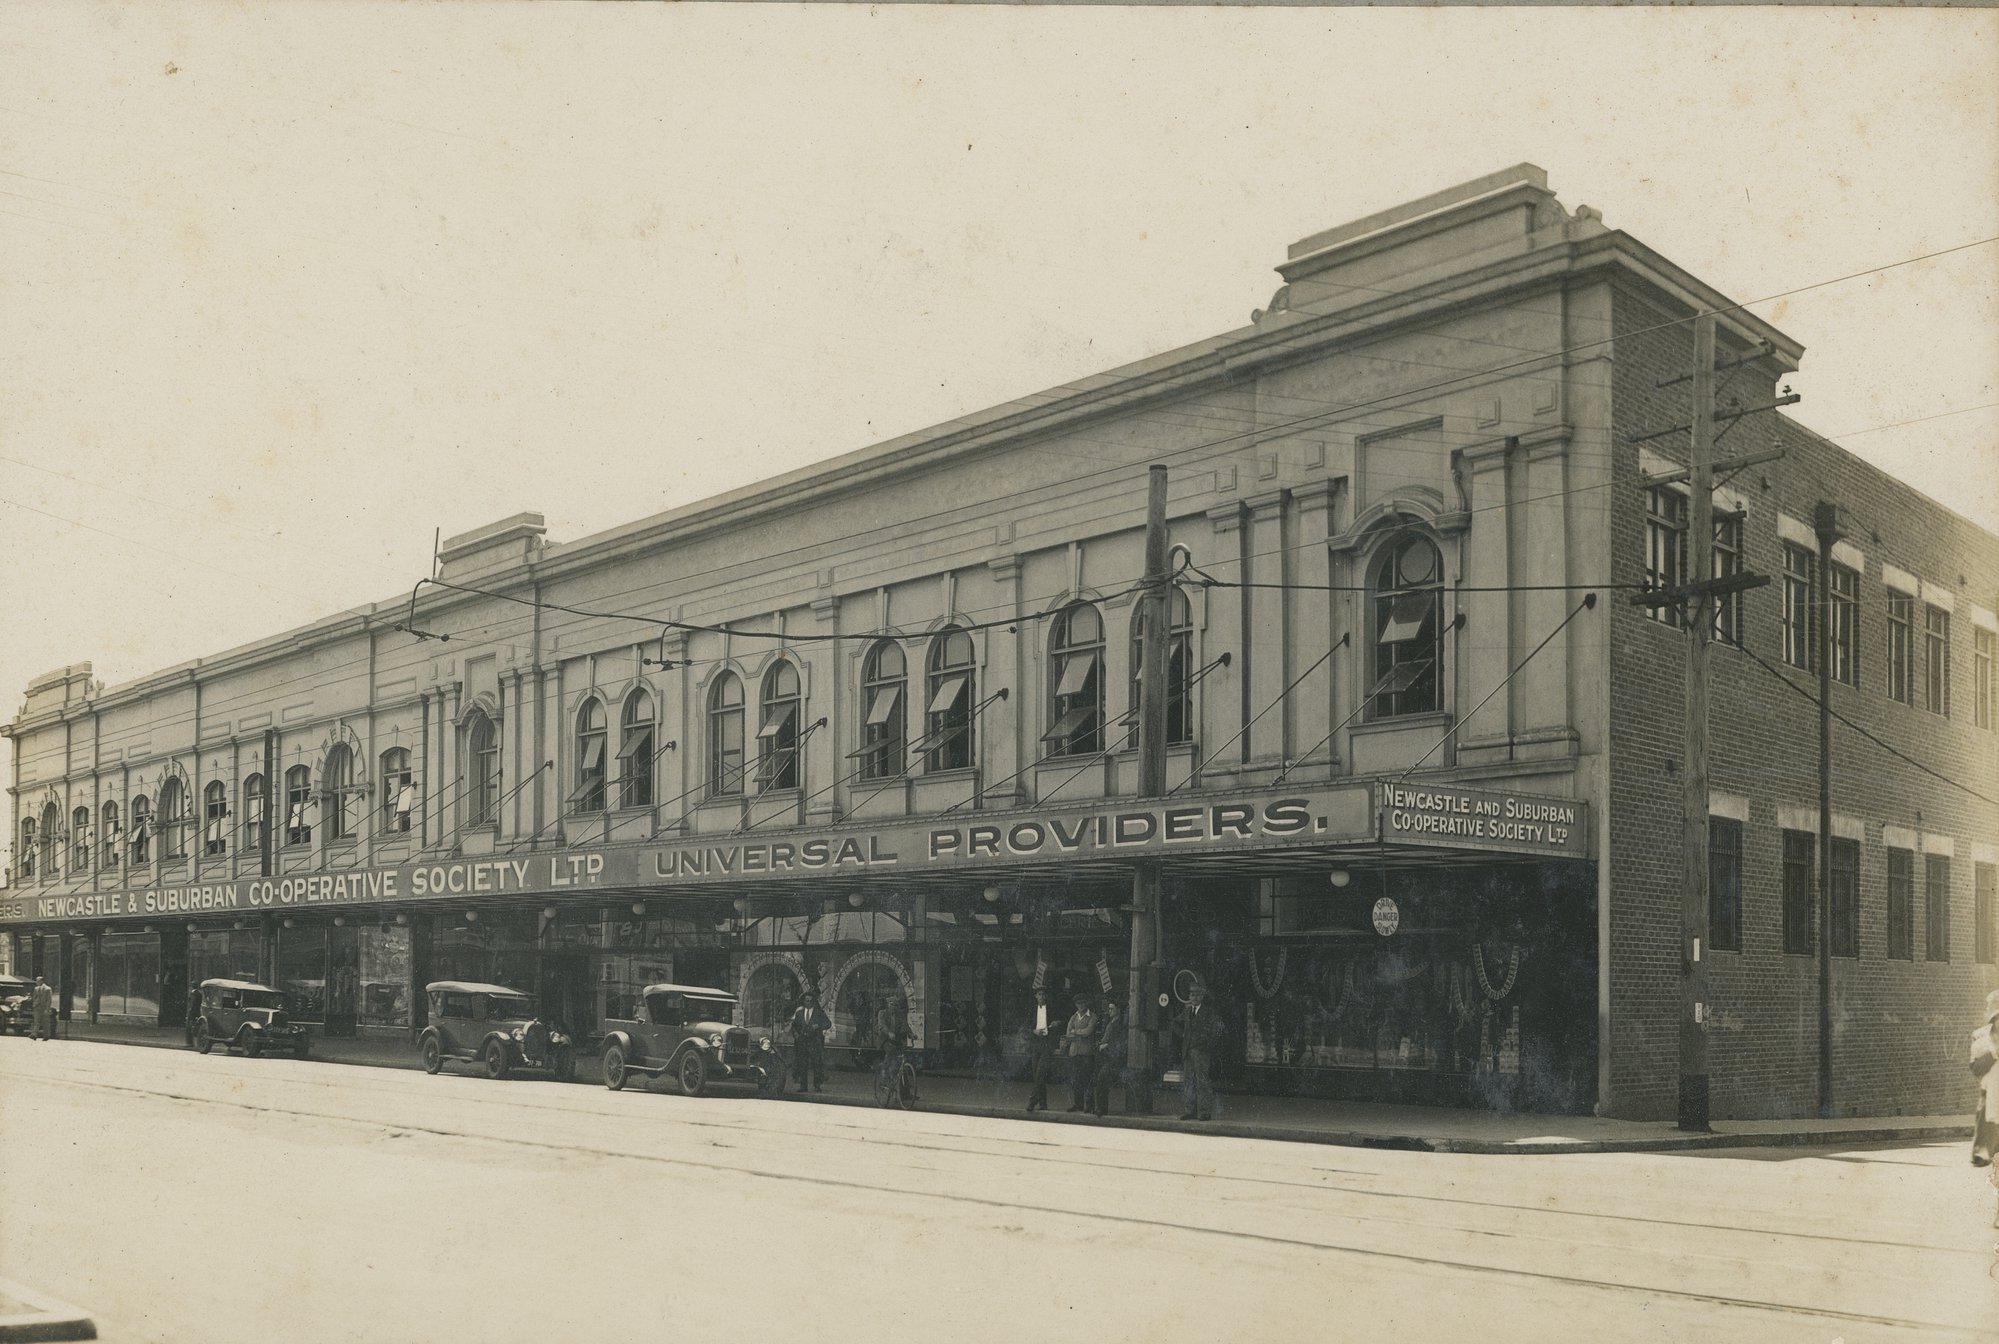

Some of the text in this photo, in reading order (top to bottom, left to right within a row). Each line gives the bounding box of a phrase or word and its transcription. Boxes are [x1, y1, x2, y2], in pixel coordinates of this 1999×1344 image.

[1384, 784, 1575, 824] NEWCASTLE AND SUBURBAN
[655, 799, 1328, 878] UNIVERSAL PROVIDERS.
[1489, 819, 1543, 842] SOCIETY
[38, 894, 121, 918] NEWCASTLE
[127, 892, 138, 914] &
[145, 884, 237, 912] SUBURBAN
[249, 870, 398, 905] CO-OPERATIVE
[412, 859, 530, 895] SOCIETY
[1374, 911, 1398, 922] DANGER
[1376, 898, 1396, 911] DRIVE
